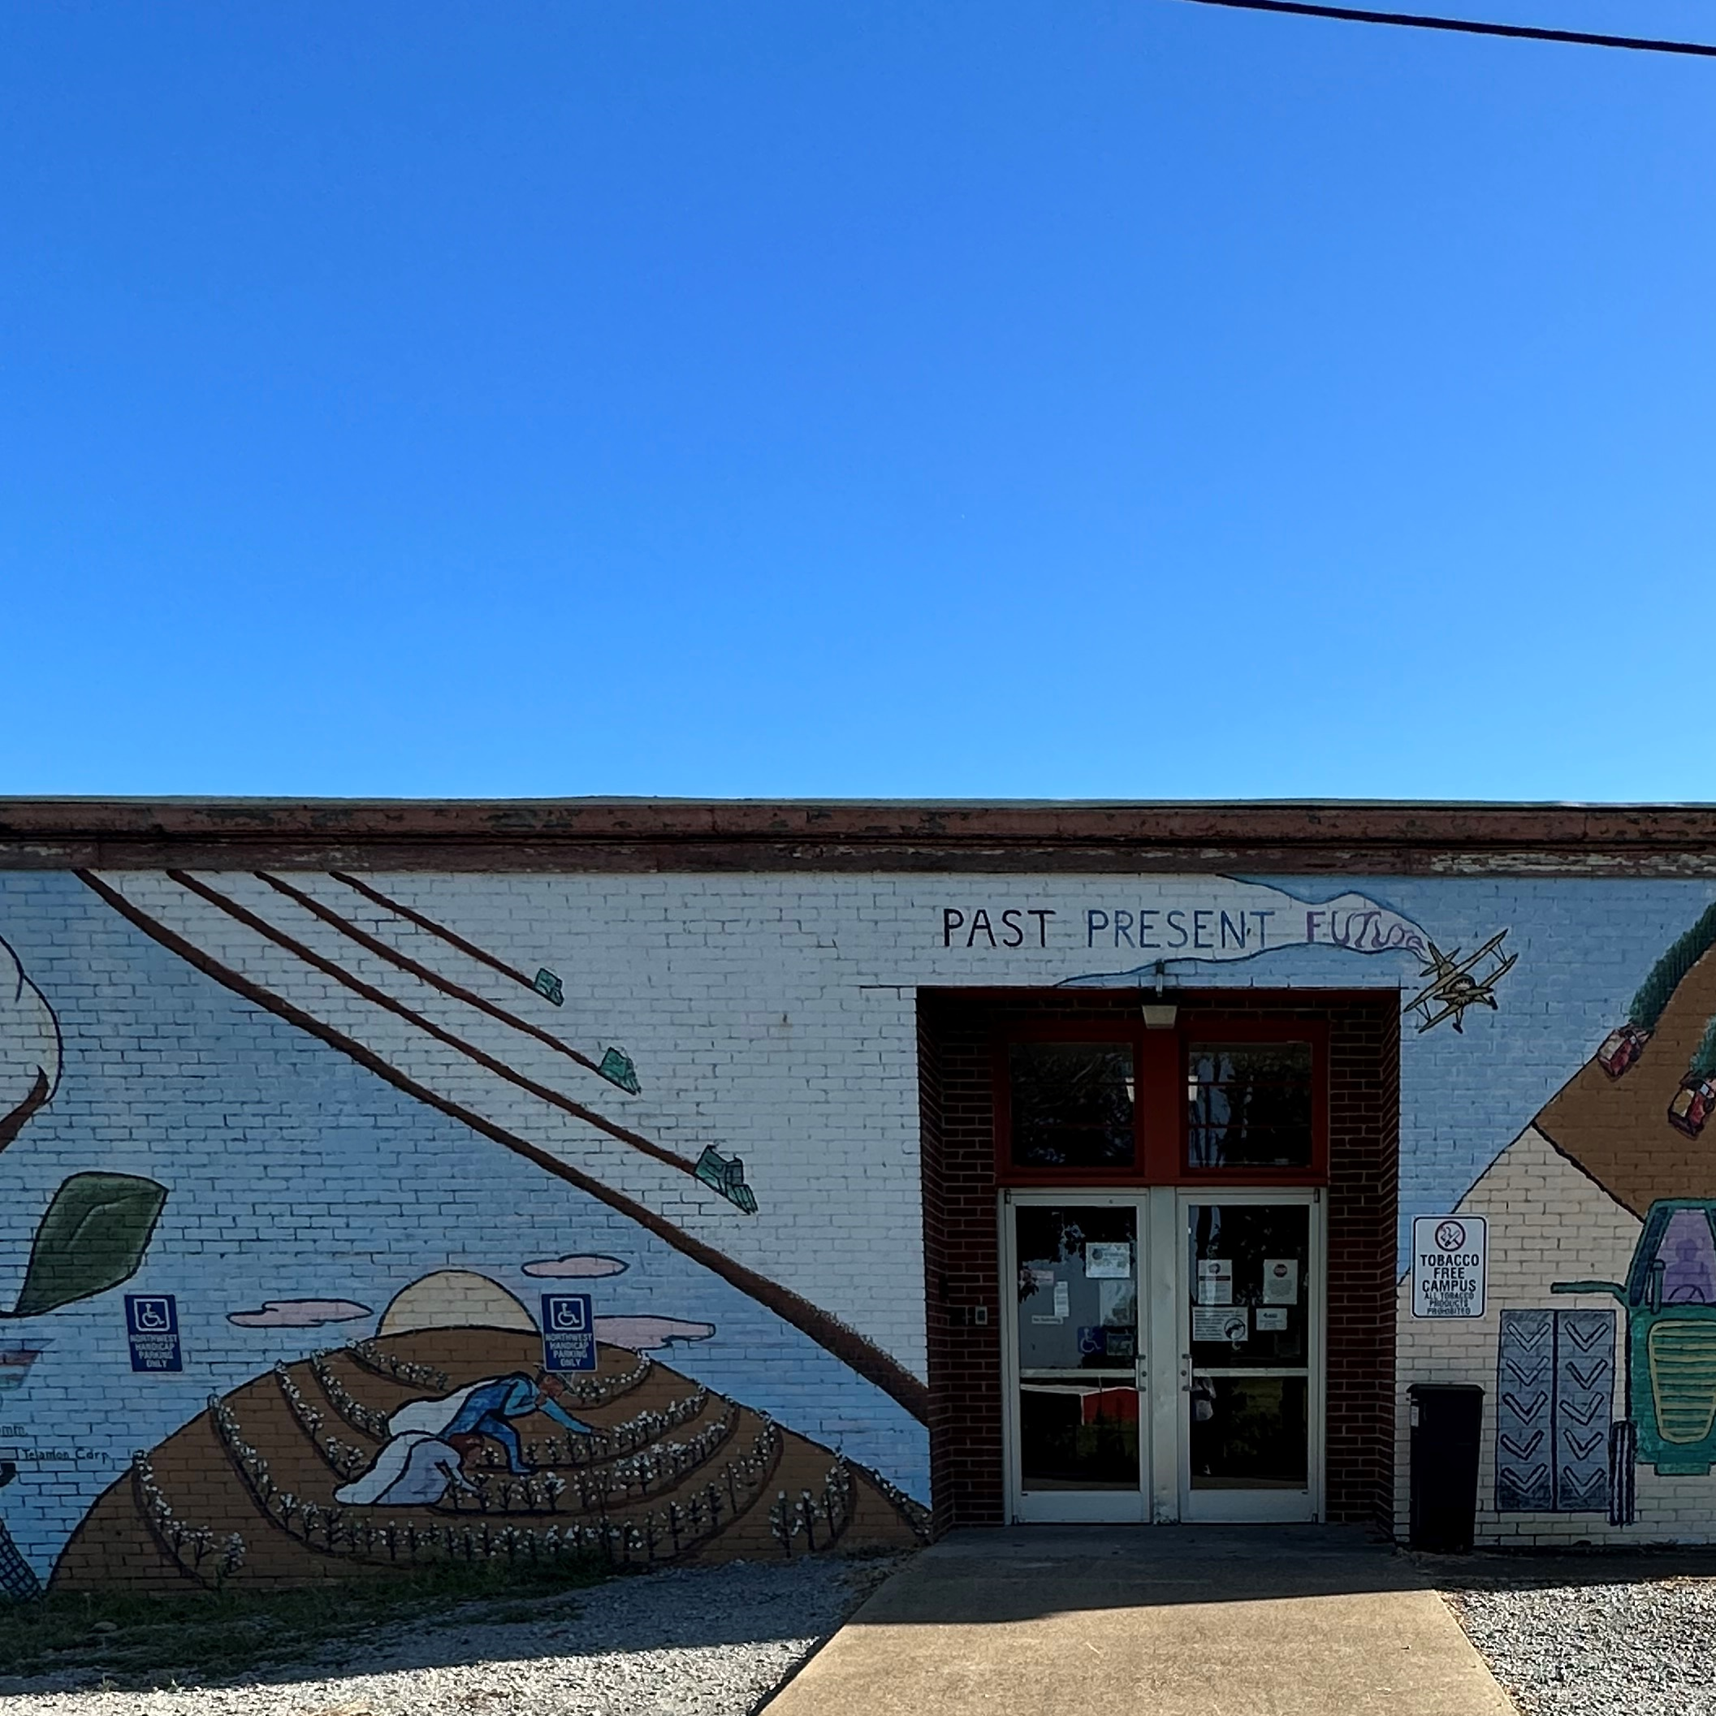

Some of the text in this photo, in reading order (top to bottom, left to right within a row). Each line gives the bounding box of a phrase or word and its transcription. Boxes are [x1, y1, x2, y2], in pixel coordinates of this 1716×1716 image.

[943, 909, 1056, 948] PAST
[1087, 909, 1276, 949] PRESENT
[1420, 1254, 1480, 1267] TOBACCO
[1433, 1267, 1465, 1279] FREE
[1422, 1280, 1476, 1292] CAMPUS
[1424, 1292, 1475, 1300] ALL TOBACCO
[1429, 1300, 1469, 1308] PRODUCTS
[1427, 1307, 1471, 1315] PROHIBITED
[135, 1343, 175, 1351] HANDICAP
[550, 1341, 589, 1350] HANDICAP
[139, 1351, 174, 1359] PARKING
[553, 1350, 588, 1359] PARKING
[146, 1359, 168, 1368] ONLY
[560, 1359, 582, 1367] ONLY
